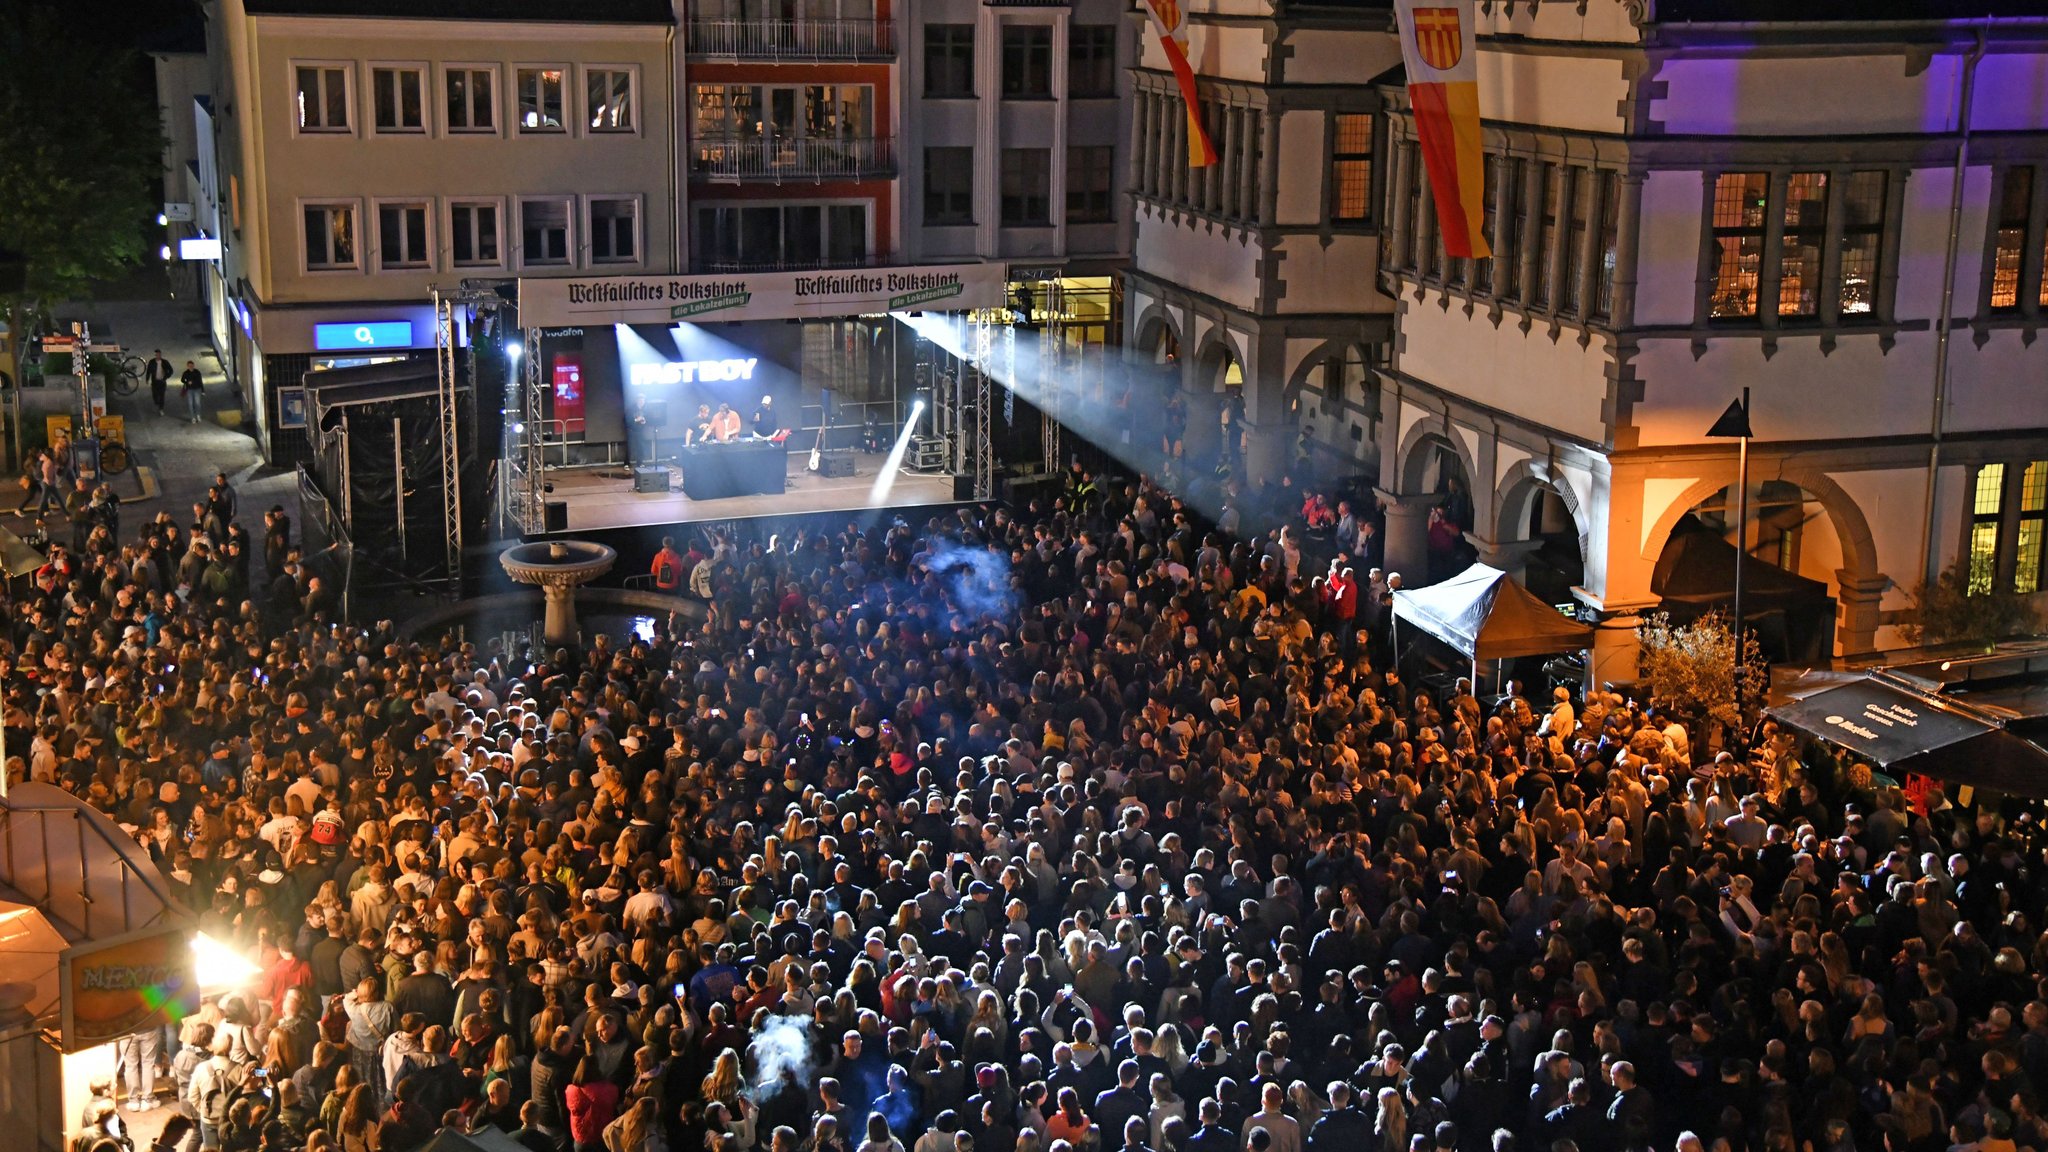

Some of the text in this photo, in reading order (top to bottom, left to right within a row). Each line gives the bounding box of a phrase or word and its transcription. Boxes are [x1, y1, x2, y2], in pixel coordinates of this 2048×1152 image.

[668, 280, 747, 300] Volksblatt
[887, 272, 959, 292] Volksblatt
[674, 294, 745, 316] die Lokalzeitung
[892, 285, 959, 307] die Lokalzeitung
[698, 357, 758, 382] BOY
[318, 824, 332, 834] 74
[81, 964, 185, 991] MEXICO
